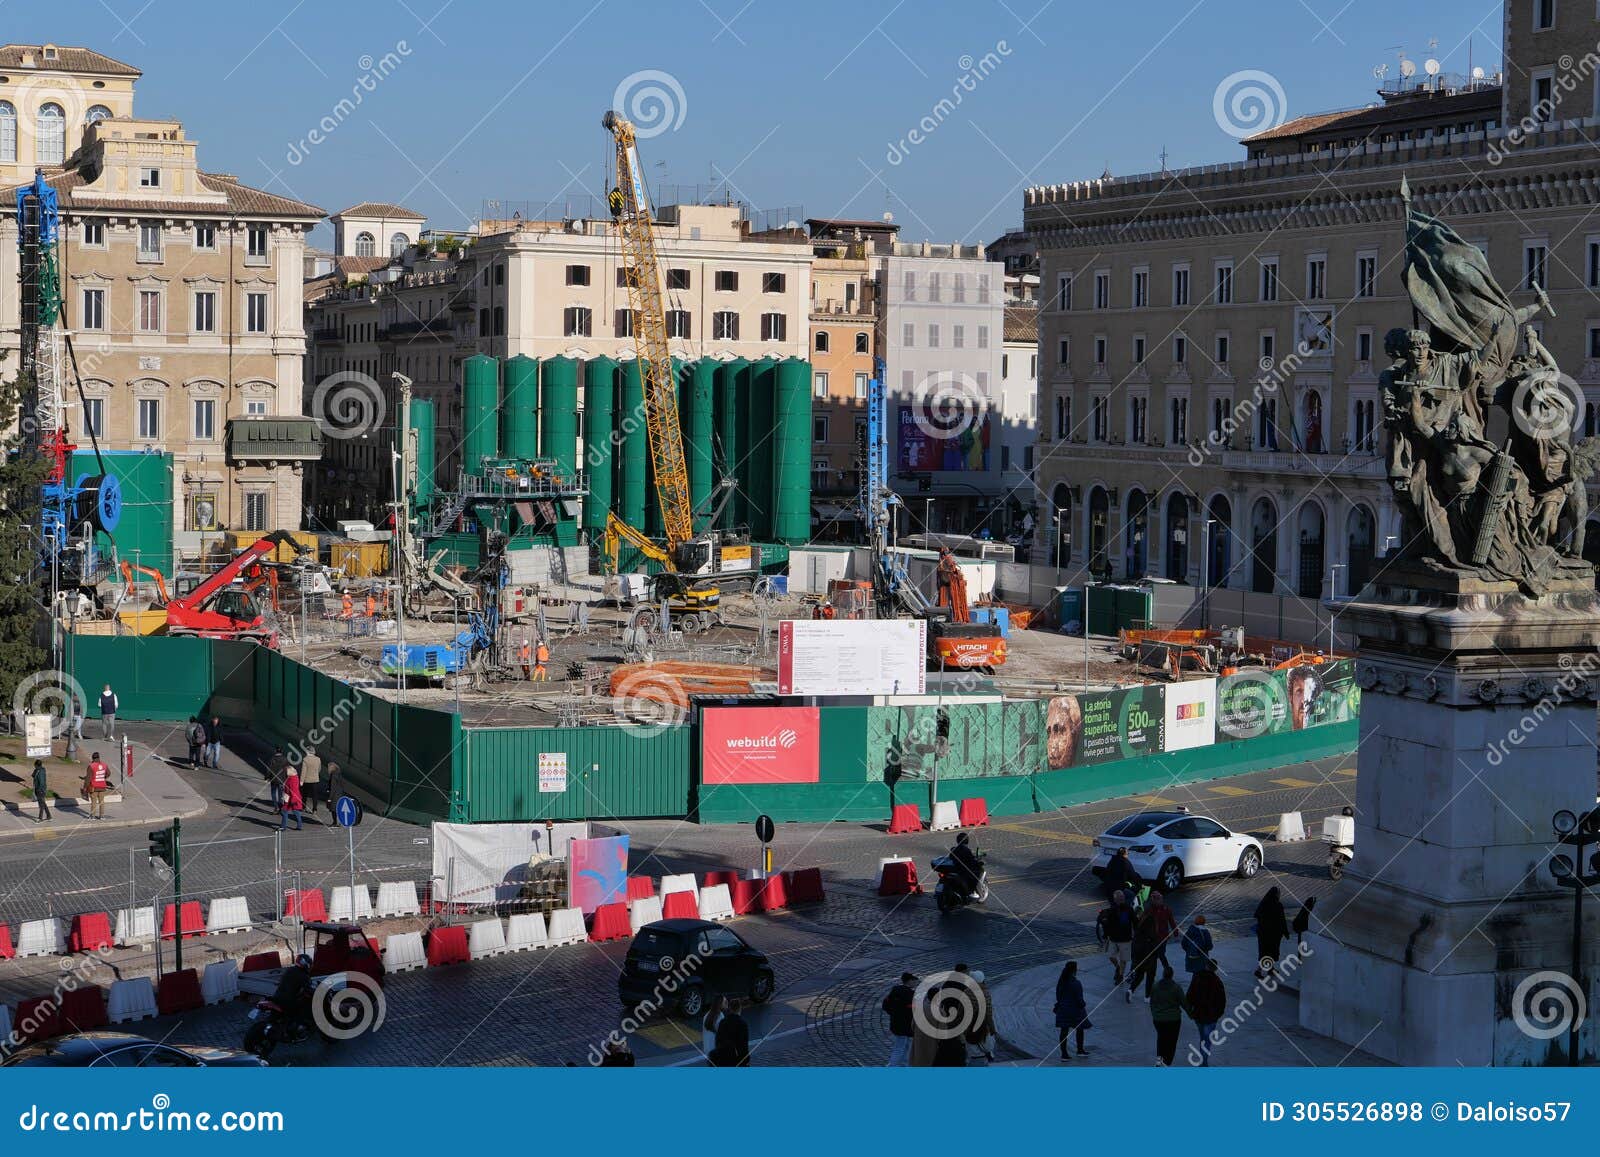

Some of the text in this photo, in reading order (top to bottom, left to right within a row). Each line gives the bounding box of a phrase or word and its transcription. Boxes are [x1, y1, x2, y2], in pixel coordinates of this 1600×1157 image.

[1085, 699, 1112, 712] La storia
[1084, 710, 1110, 723] torna in
[1084, 721, 1117, 737] superficie
[727, 736, 777, 748] webuild
